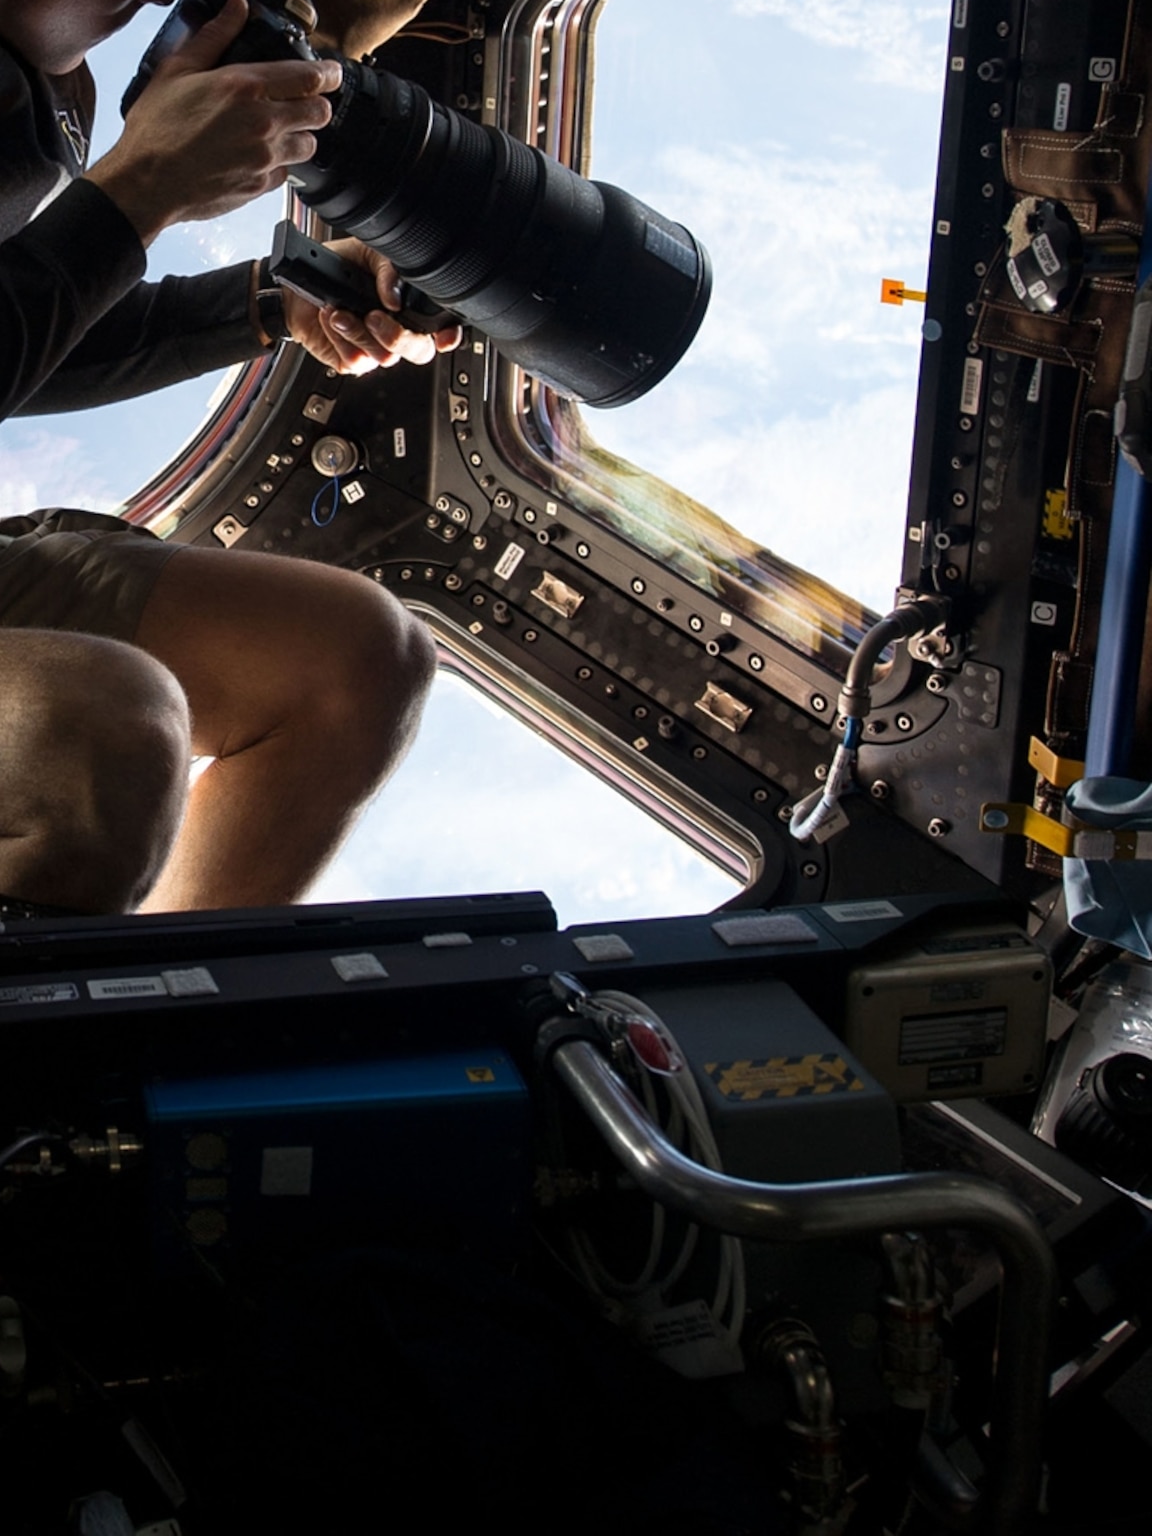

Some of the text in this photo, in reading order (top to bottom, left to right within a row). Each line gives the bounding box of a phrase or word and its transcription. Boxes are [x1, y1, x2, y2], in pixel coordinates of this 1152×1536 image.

[1092, 61, 1112, 78] G
[1037, 239, 1059, 267] CLOSED
[345, 484, 361, 500] H
[1033, 604, 1053, 622] C
